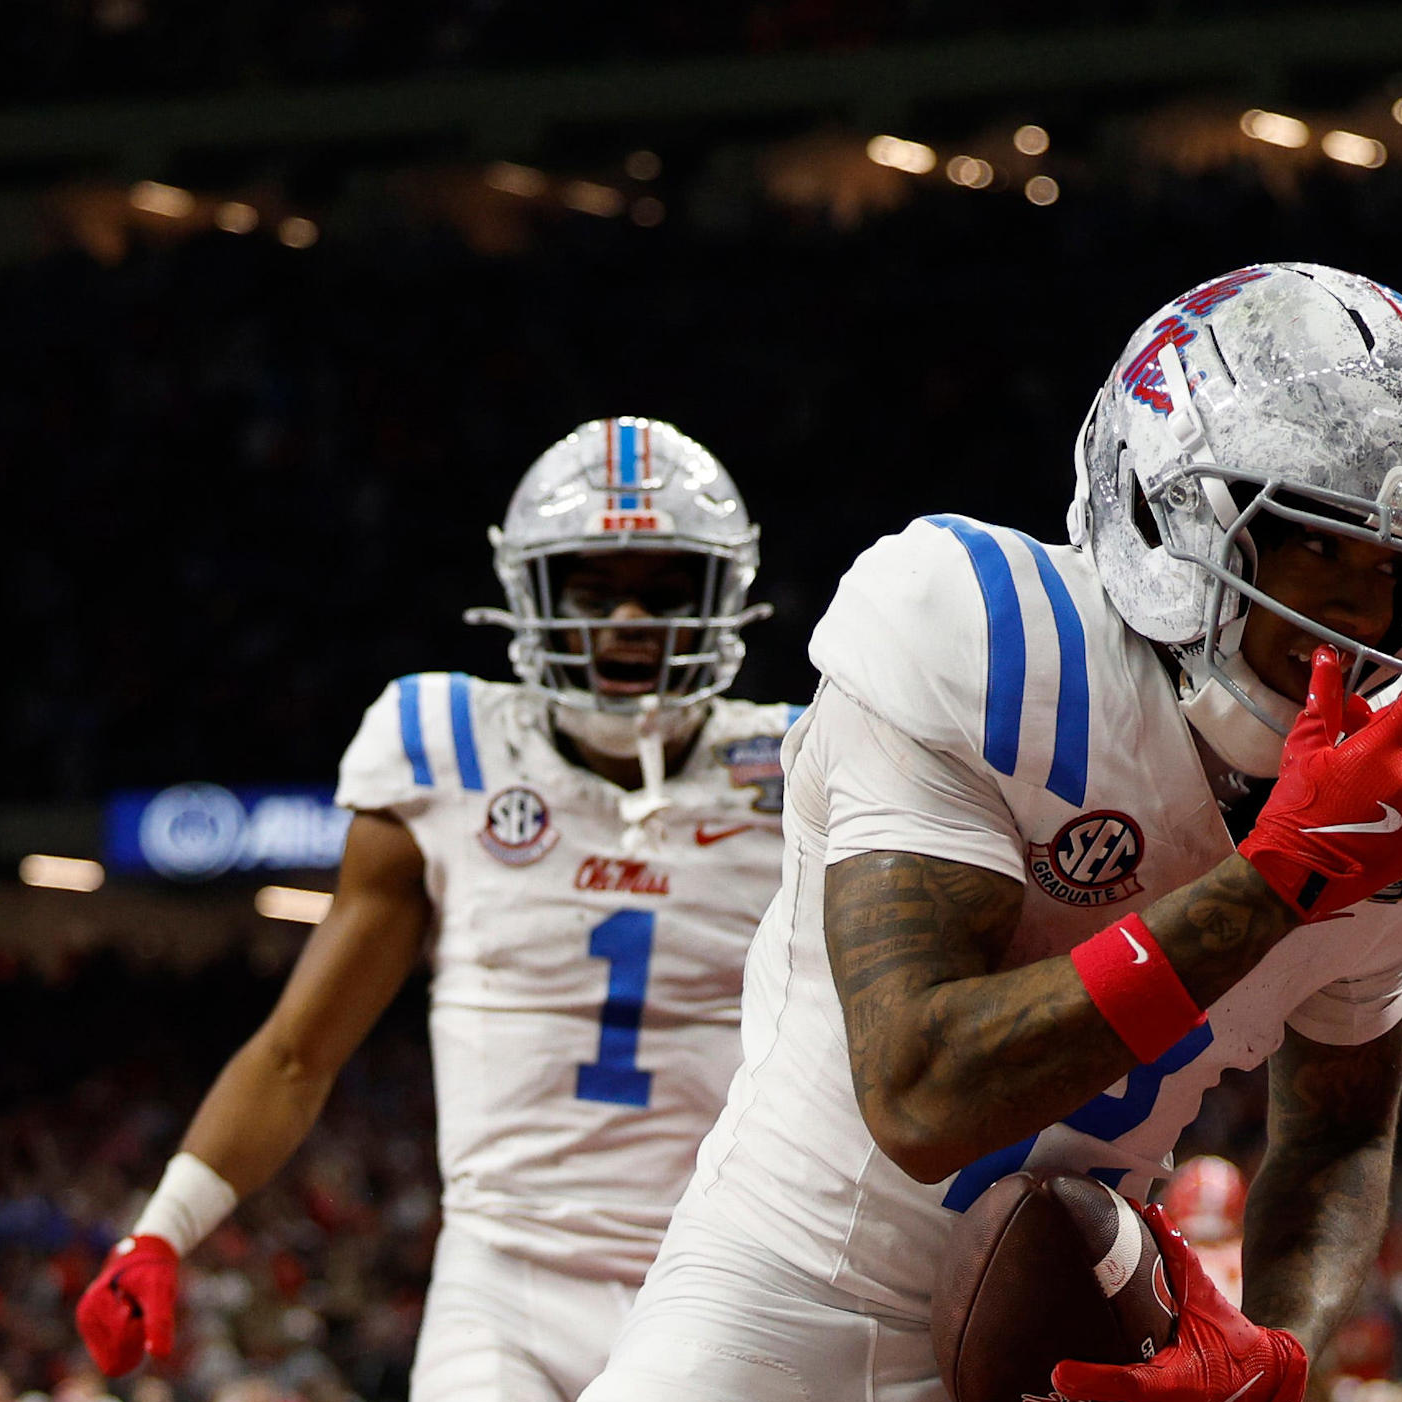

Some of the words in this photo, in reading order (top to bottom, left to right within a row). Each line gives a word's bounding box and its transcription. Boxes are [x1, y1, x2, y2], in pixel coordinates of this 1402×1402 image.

[490, 788, 546, 845] SEC
[1057, 818, 1136, 884] SEC
[1033, 861, 1117, 905] GRADUATE
[576, 907, 655, 1108] 1
